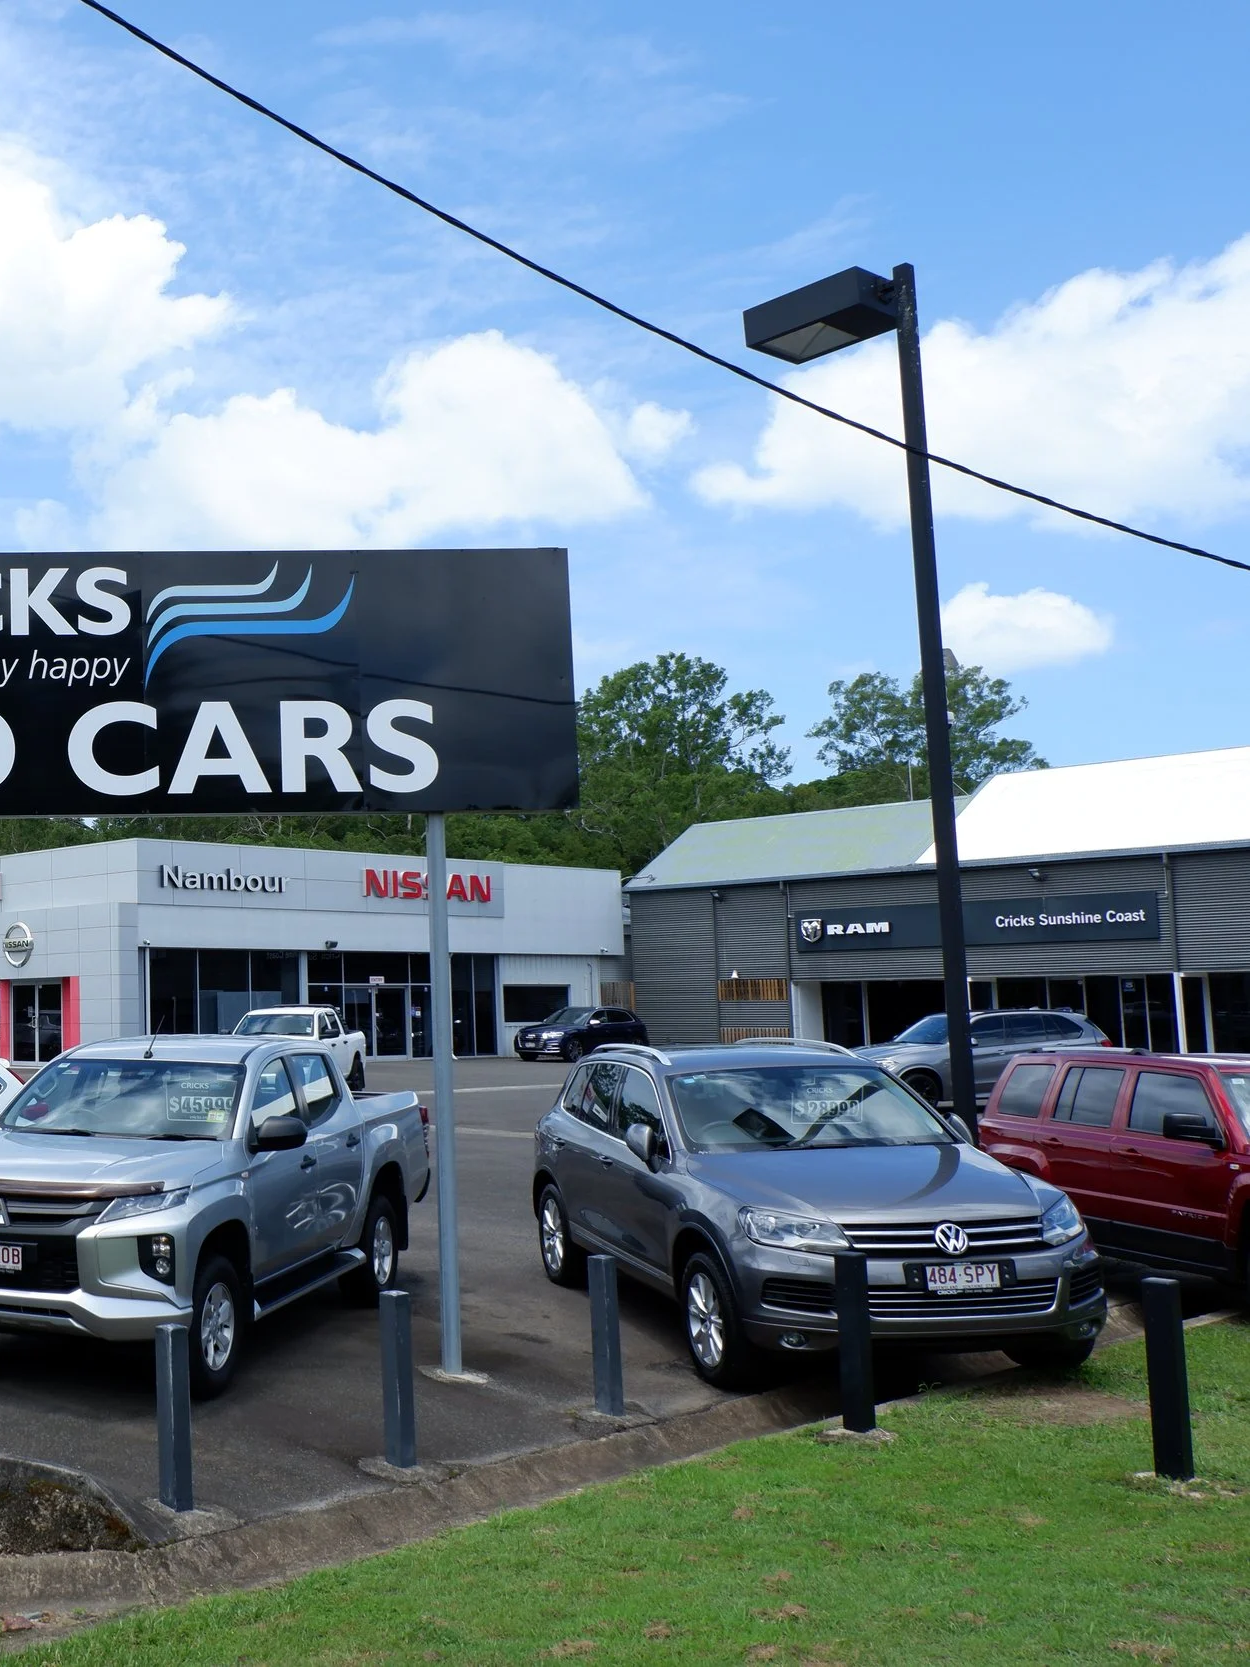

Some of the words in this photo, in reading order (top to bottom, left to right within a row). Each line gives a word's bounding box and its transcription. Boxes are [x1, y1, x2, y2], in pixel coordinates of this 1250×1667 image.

[29, 649, 131, 687] happy
[67, 698, 440, 796] CARS
[160, 864, 290, 893] Nambour
[365, 868, 491, 903] NISAN
[826, 921, 890, 936] RAM
[995, 914, 1035, 928] Cricks
[1039, 911, 1102, 926] Sunshine
[1105, 909, 1146, 923] Coast
[180, 1082, 210, 1090] CRICKS
